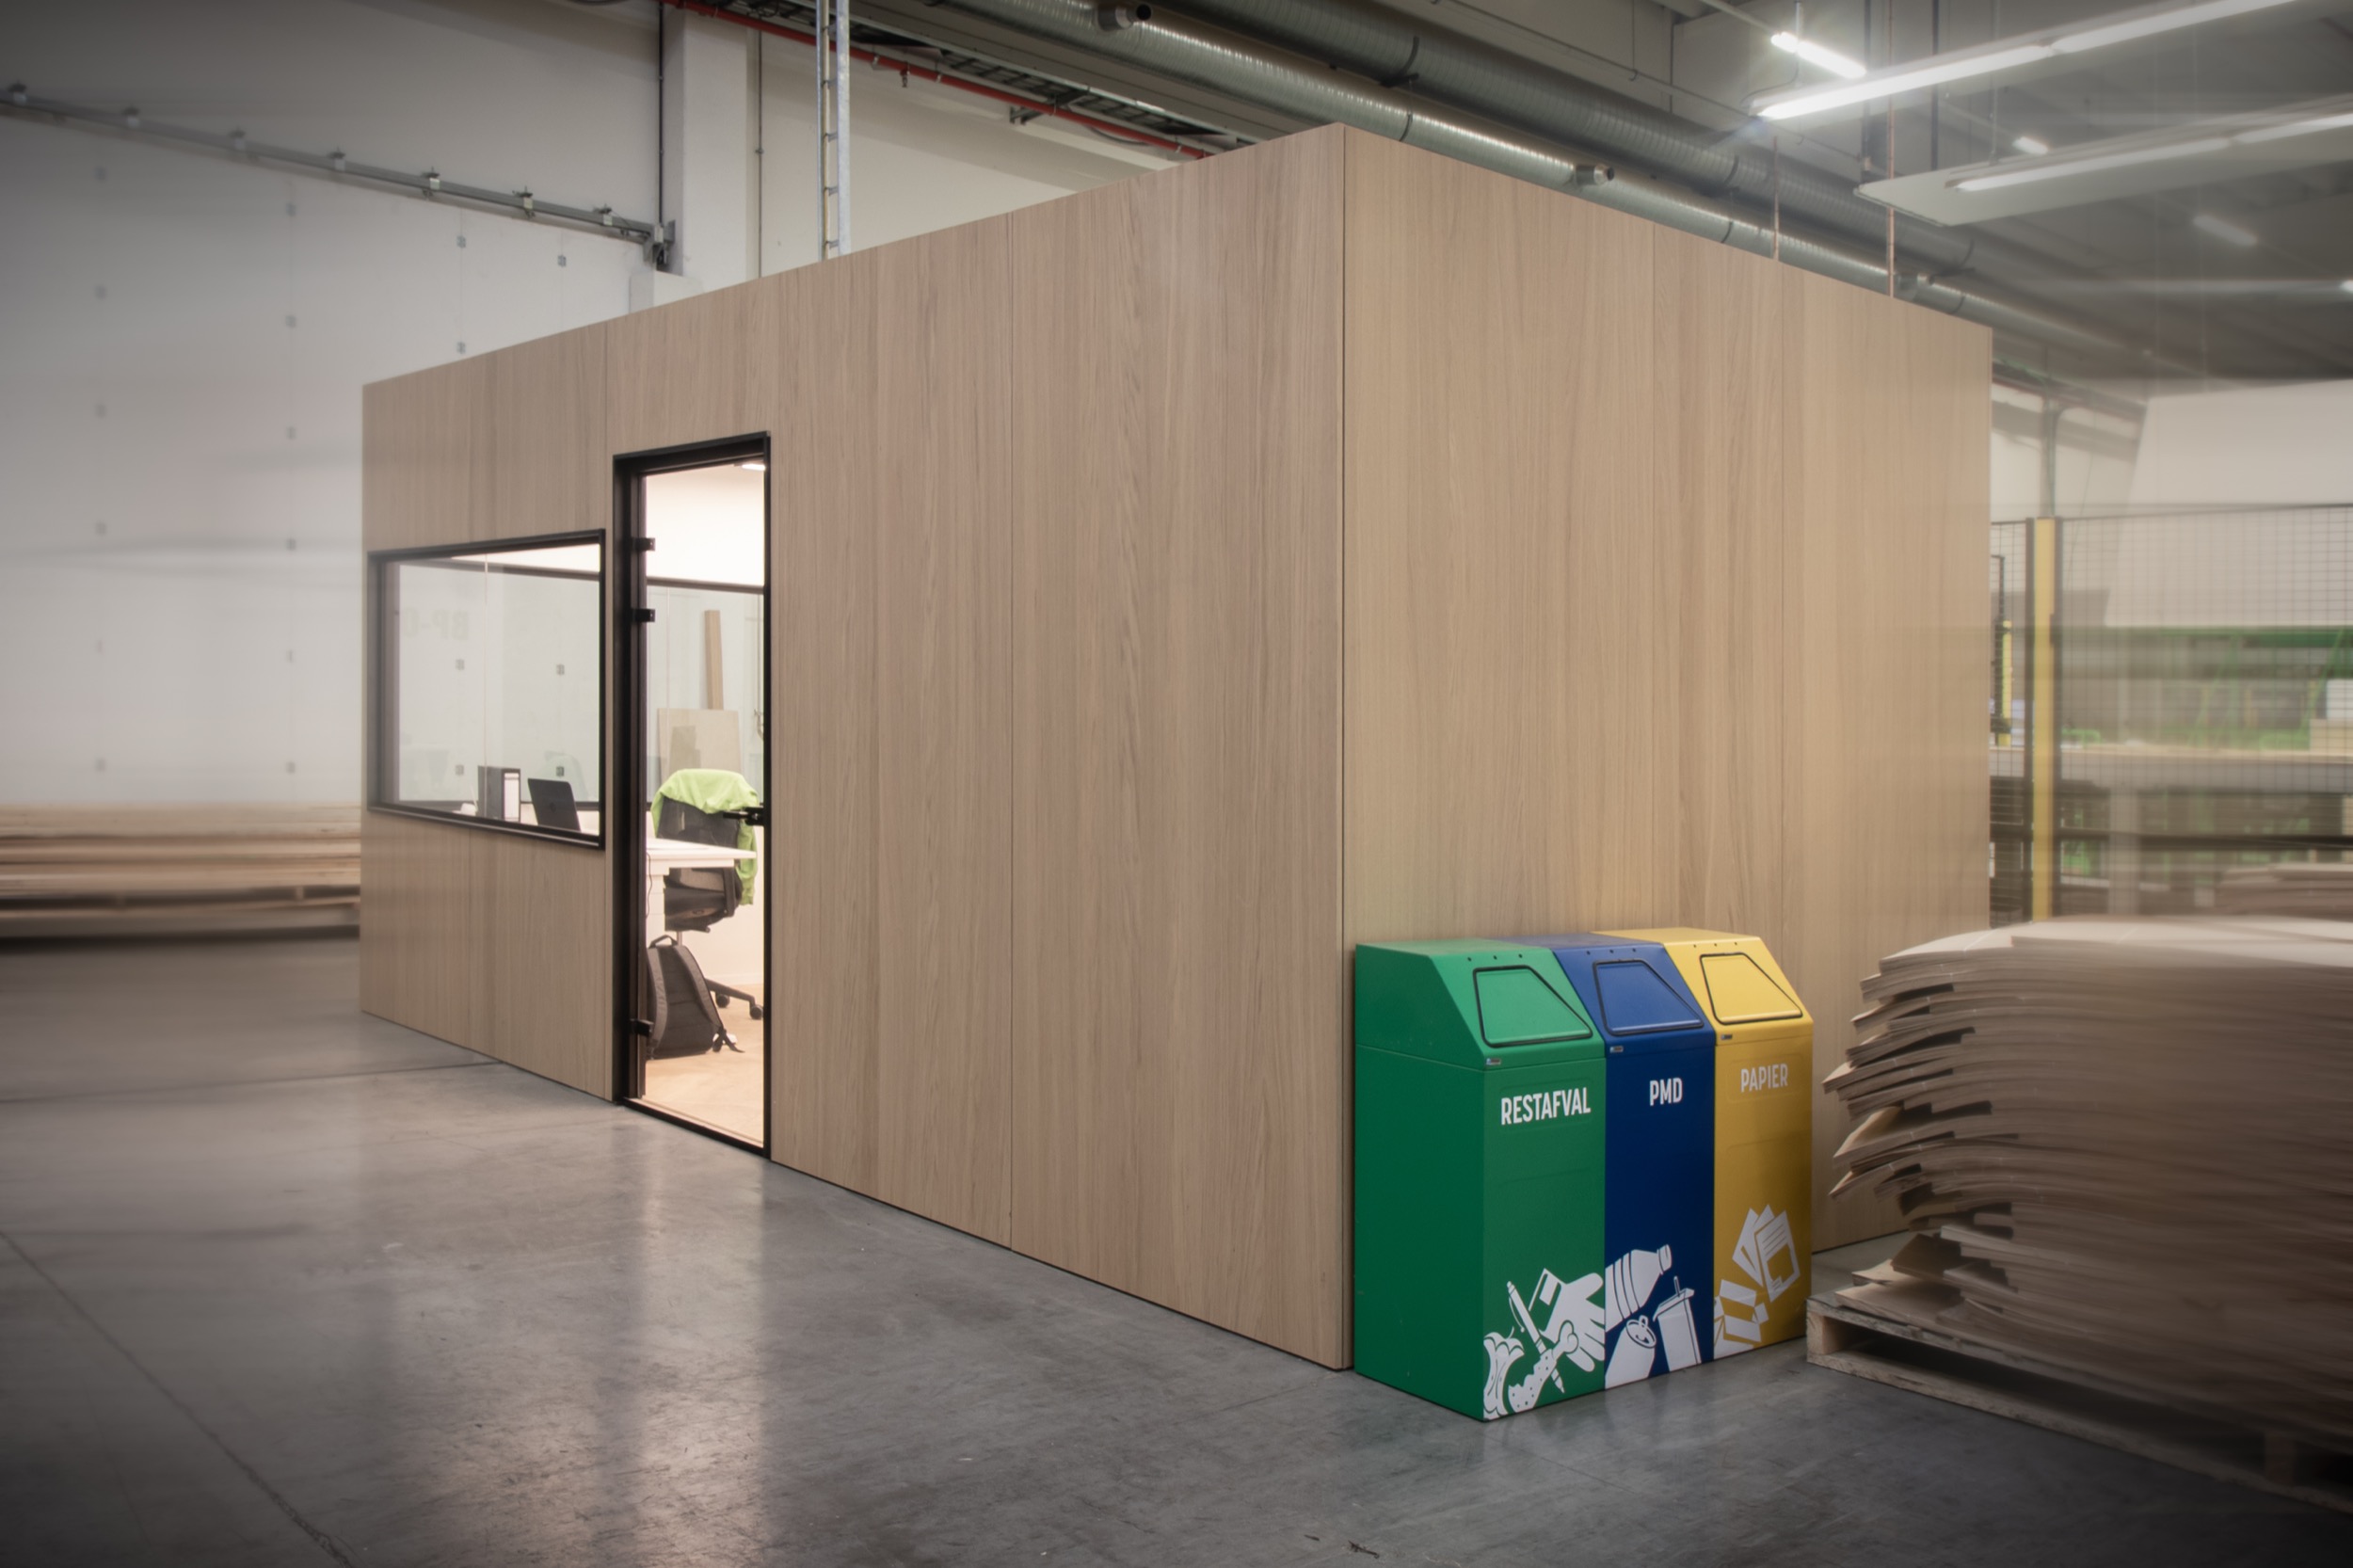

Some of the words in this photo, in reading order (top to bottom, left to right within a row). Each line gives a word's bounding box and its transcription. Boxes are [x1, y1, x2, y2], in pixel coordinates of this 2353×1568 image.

[1650, 1078, 1683, 1106] PMD
[1740, 1064, 1787, 1093] PAPIER
[1501, 1087, 1592, 1126] RESTAFVAL
